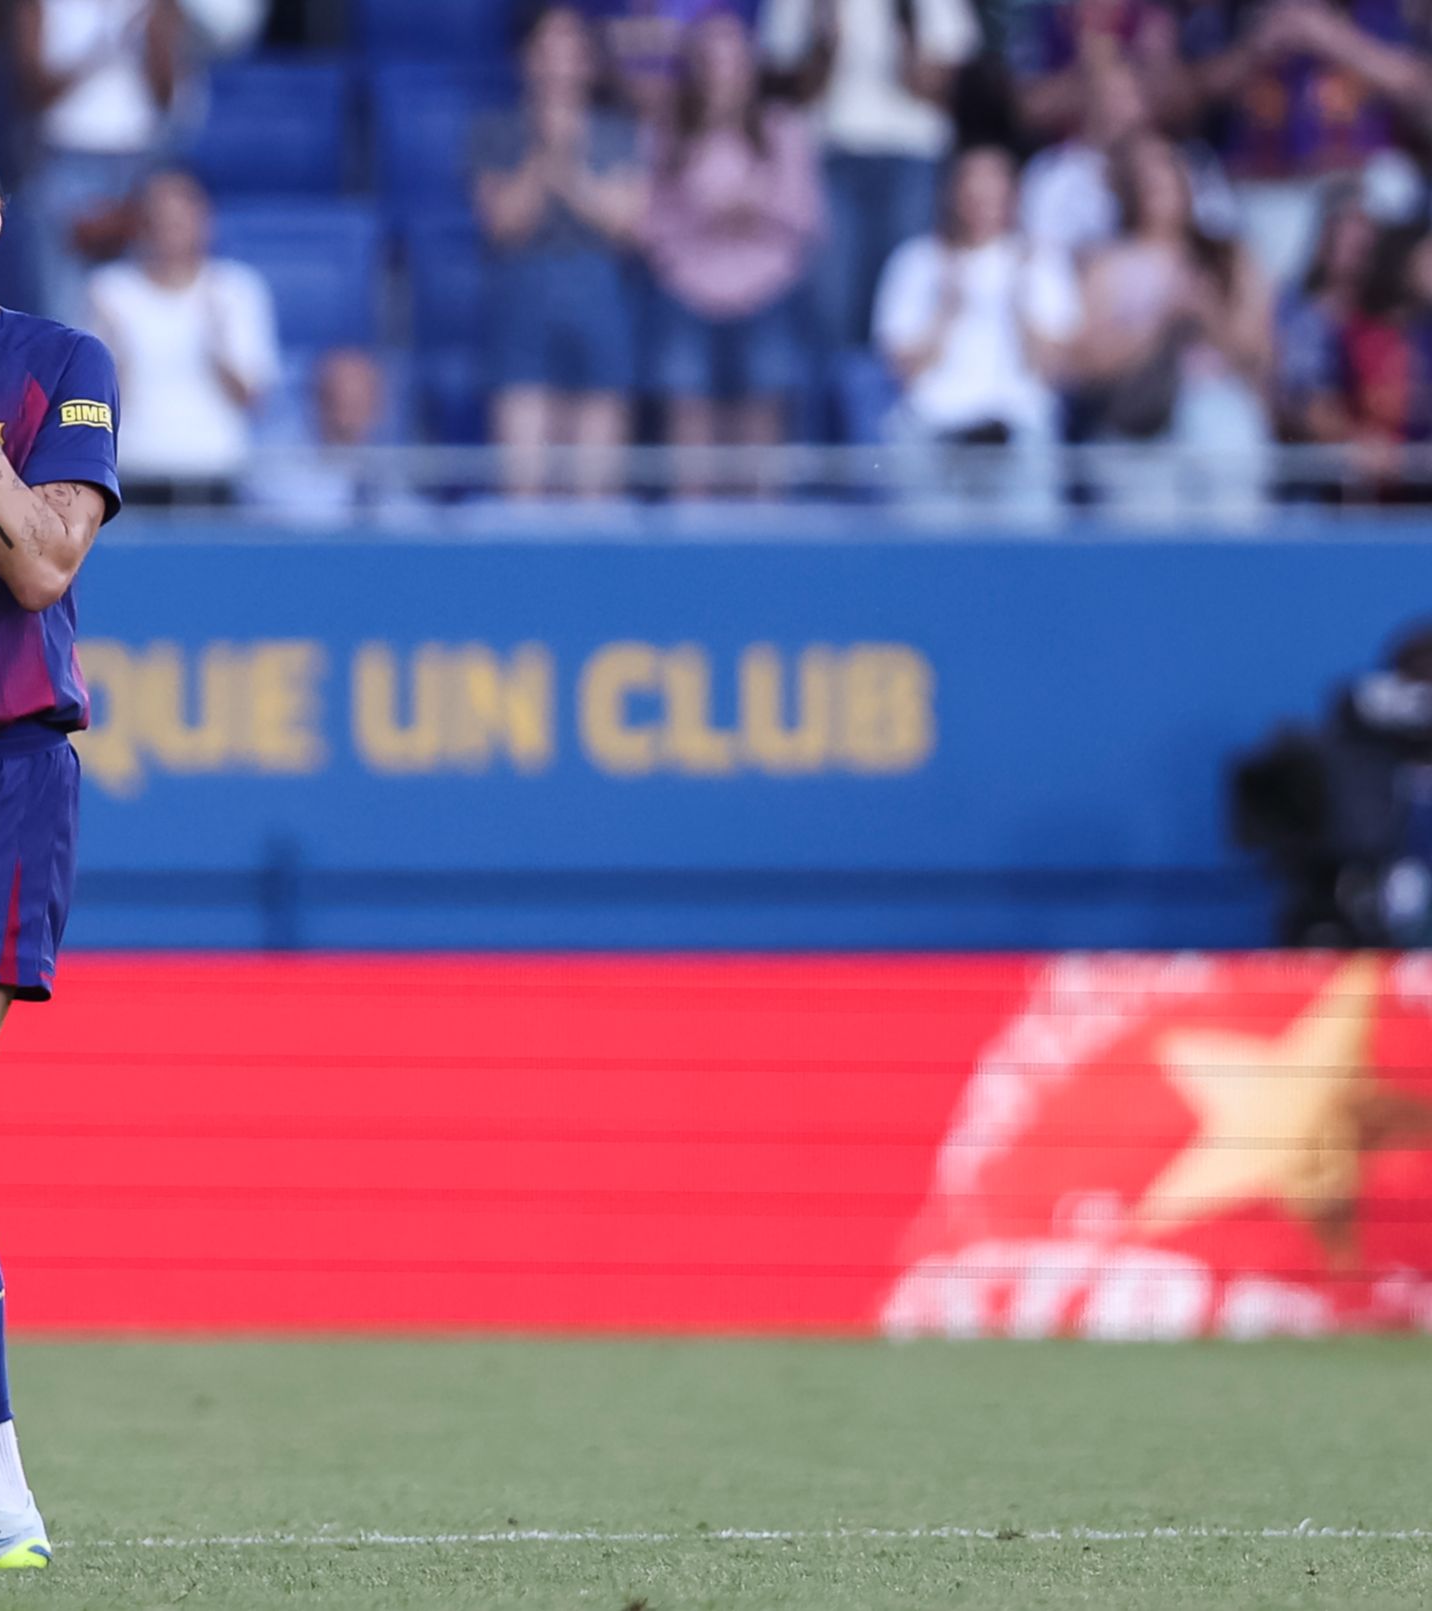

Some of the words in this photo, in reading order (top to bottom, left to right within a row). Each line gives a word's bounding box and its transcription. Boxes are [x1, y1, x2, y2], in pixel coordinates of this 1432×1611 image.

[61, 405, 111, 424] BIMB
[352, 640, 555, 776] UN
[577, 640, 936, 776] CLUB
